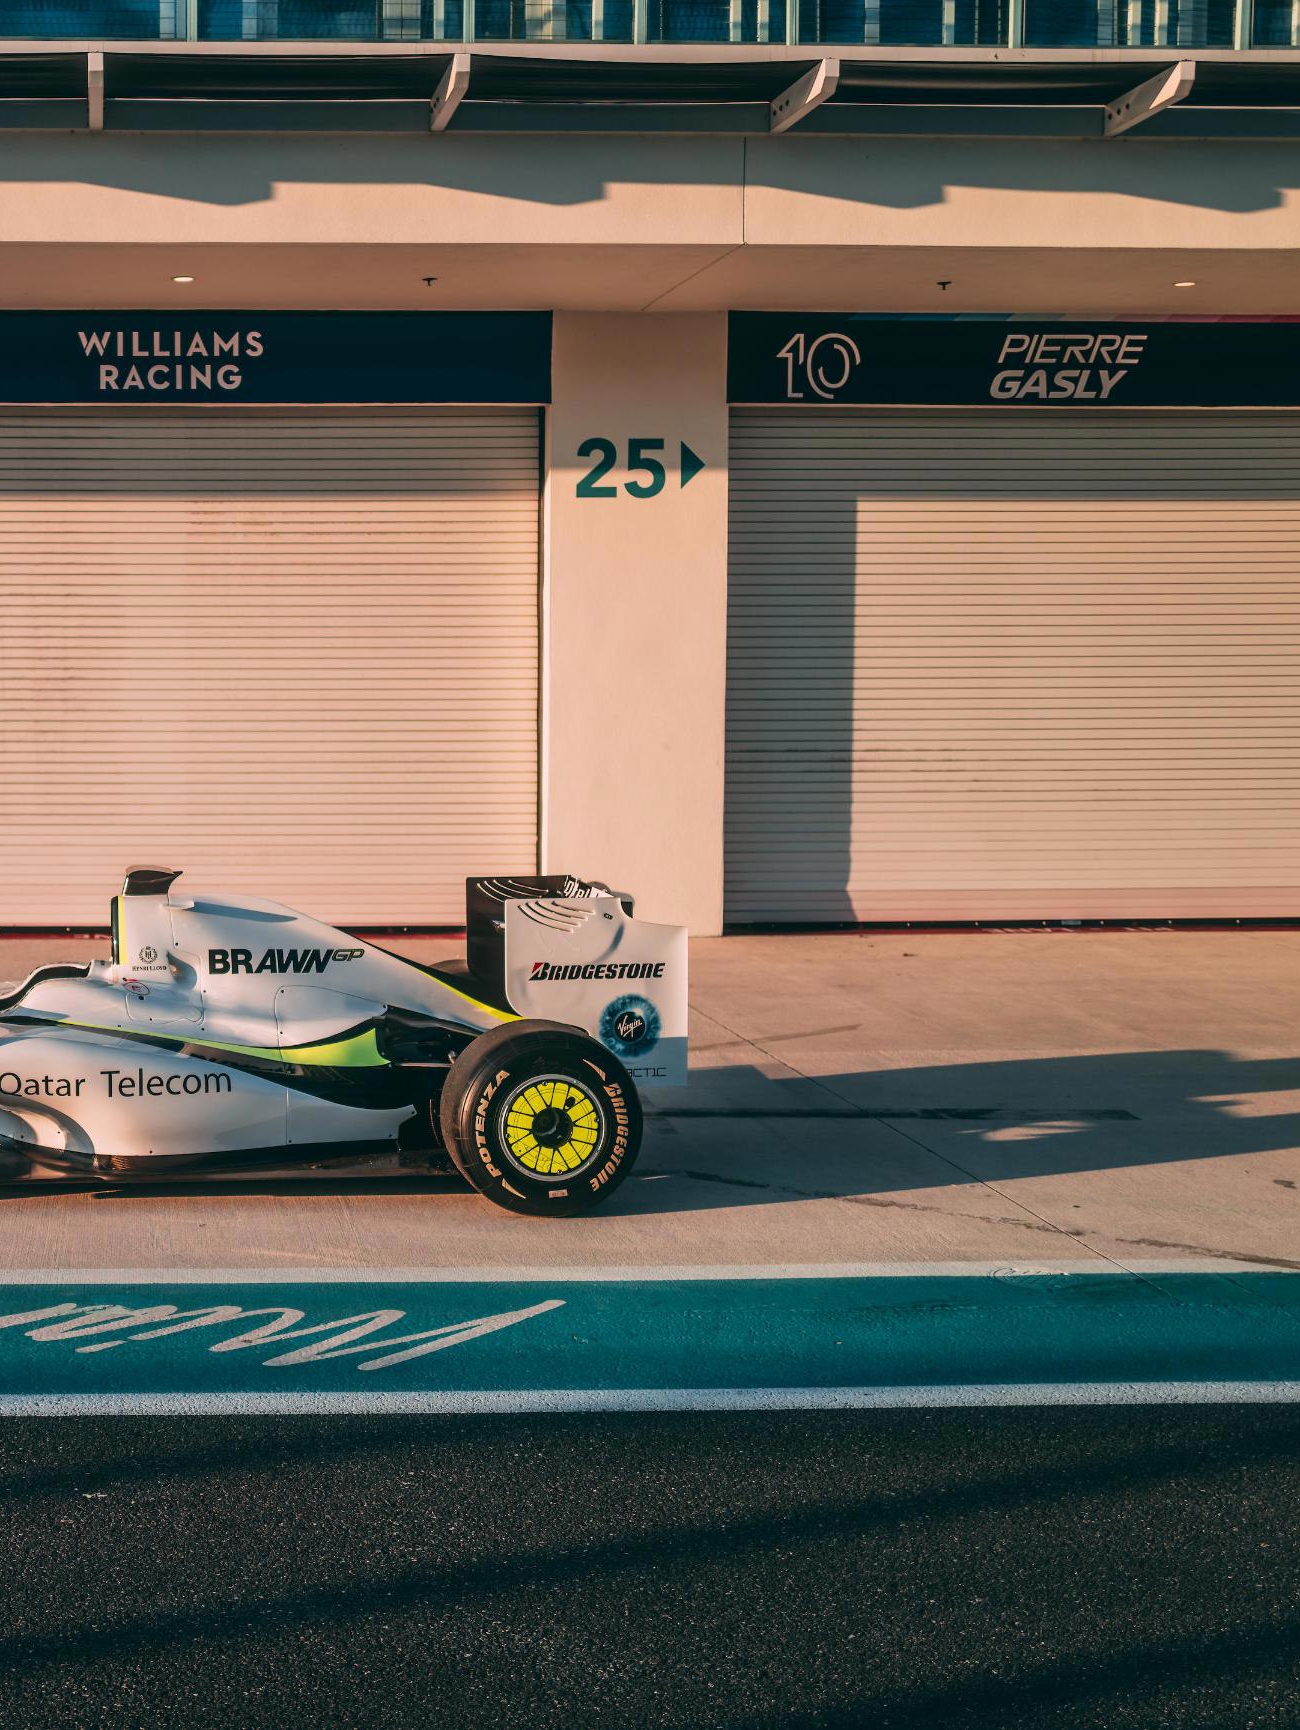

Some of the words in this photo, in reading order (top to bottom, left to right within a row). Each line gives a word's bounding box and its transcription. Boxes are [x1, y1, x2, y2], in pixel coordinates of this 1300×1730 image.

[77, 331, 264, 357] WILLIAMS
[996, 334, 1148, 364] PIERRE
[99, 364, 242, 390] RACING
[776, 332, 861, 400] 10
[989, 369, 1128, 399] GASLY
[575, 437, 666, 499] 25
[208, 948, 334, 975] BRAWN
[528, 962, 666, 982] BRIDGESTONE
[617, 1014, 643, 1038] Virgin
[100, 1067, 232, 1098] Telecom
[475, 1069, 511, 1178] POTENZA
[589, 1082, 630, 1192] BRIDGESTONE
